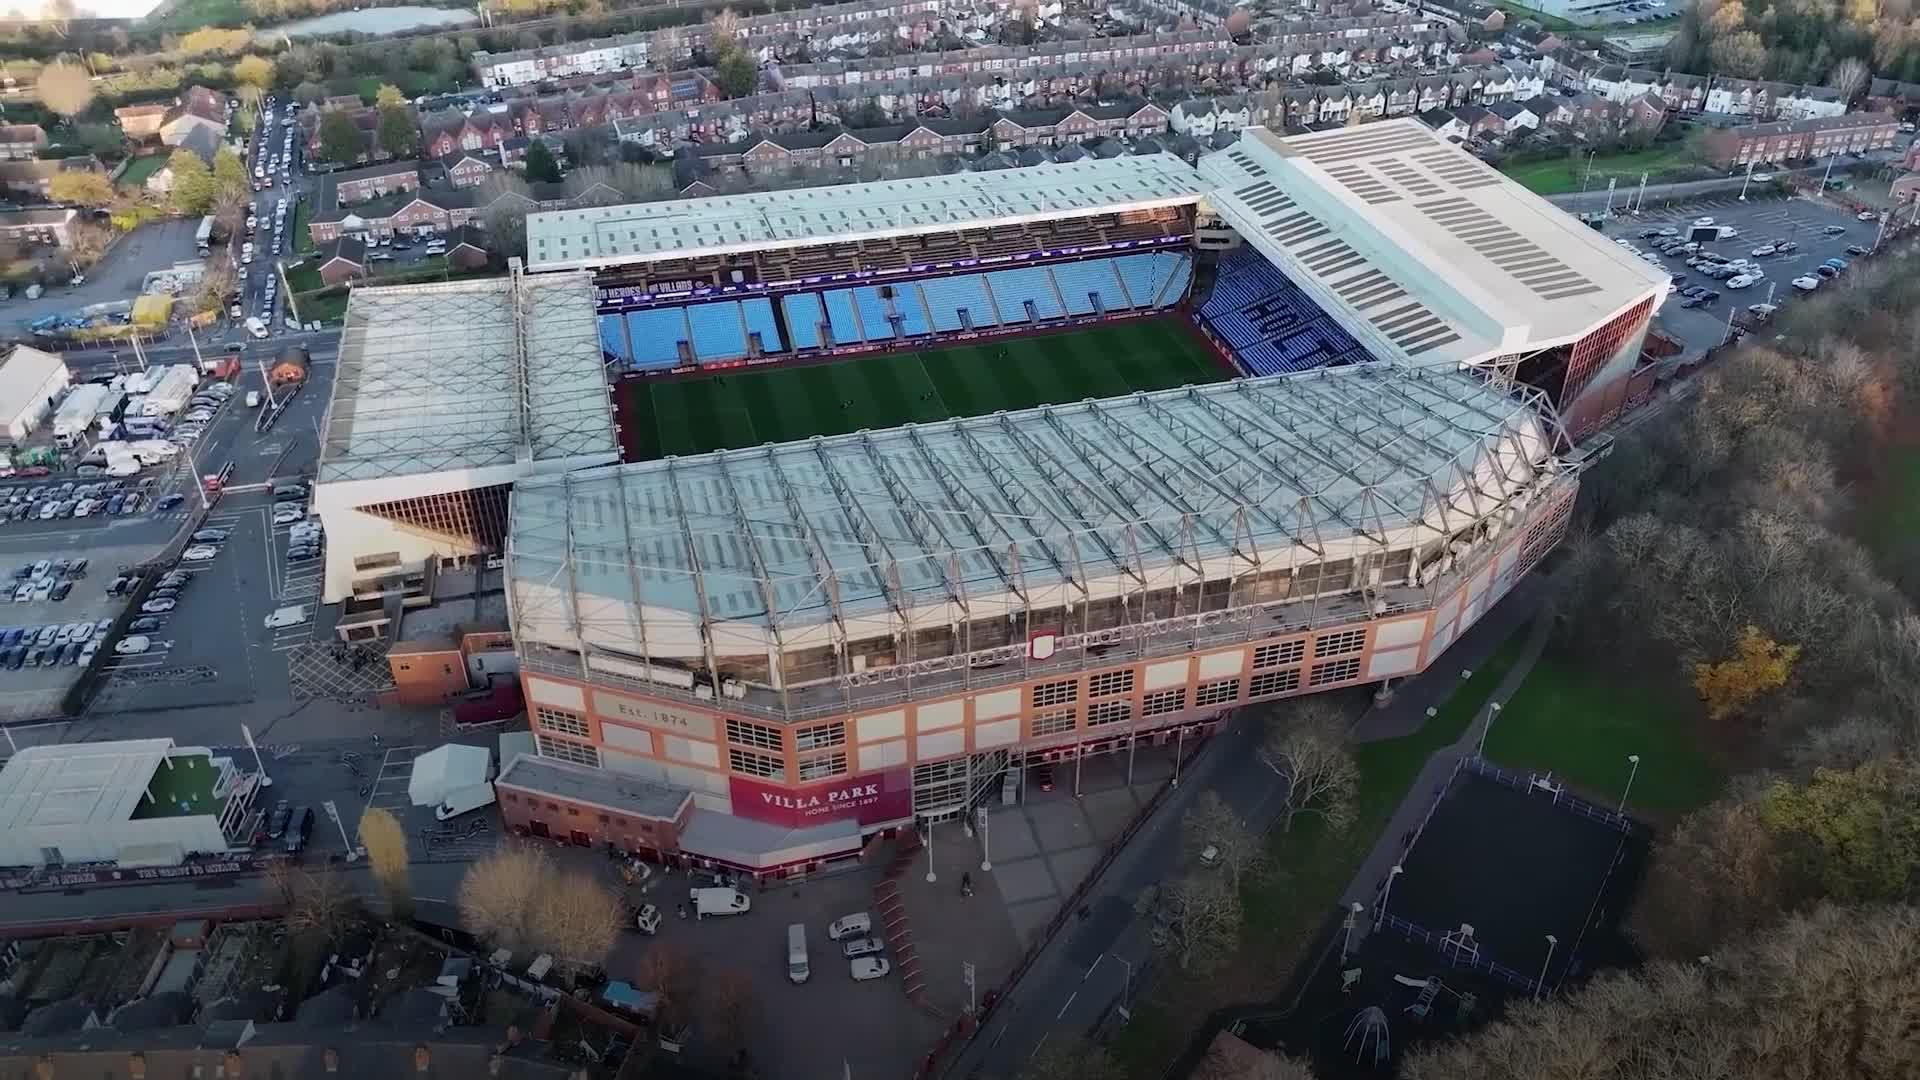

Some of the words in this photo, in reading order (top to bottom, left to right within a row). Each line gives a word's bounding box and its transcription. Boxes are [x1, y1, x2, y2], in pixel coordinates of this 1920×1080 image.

[608, 286, 641, 299] HEROES
[840, 660, 932, 689] ASTON
[944, 644, 1027, 669] VILLA
[653, 711, 688, 727] 1874
[761, 792, 820, 810] VILLA
[828, 783, 878, 802] PARK
[805, 805, 830, 817] HOME
[832, 800, 857, 811] SINCE
